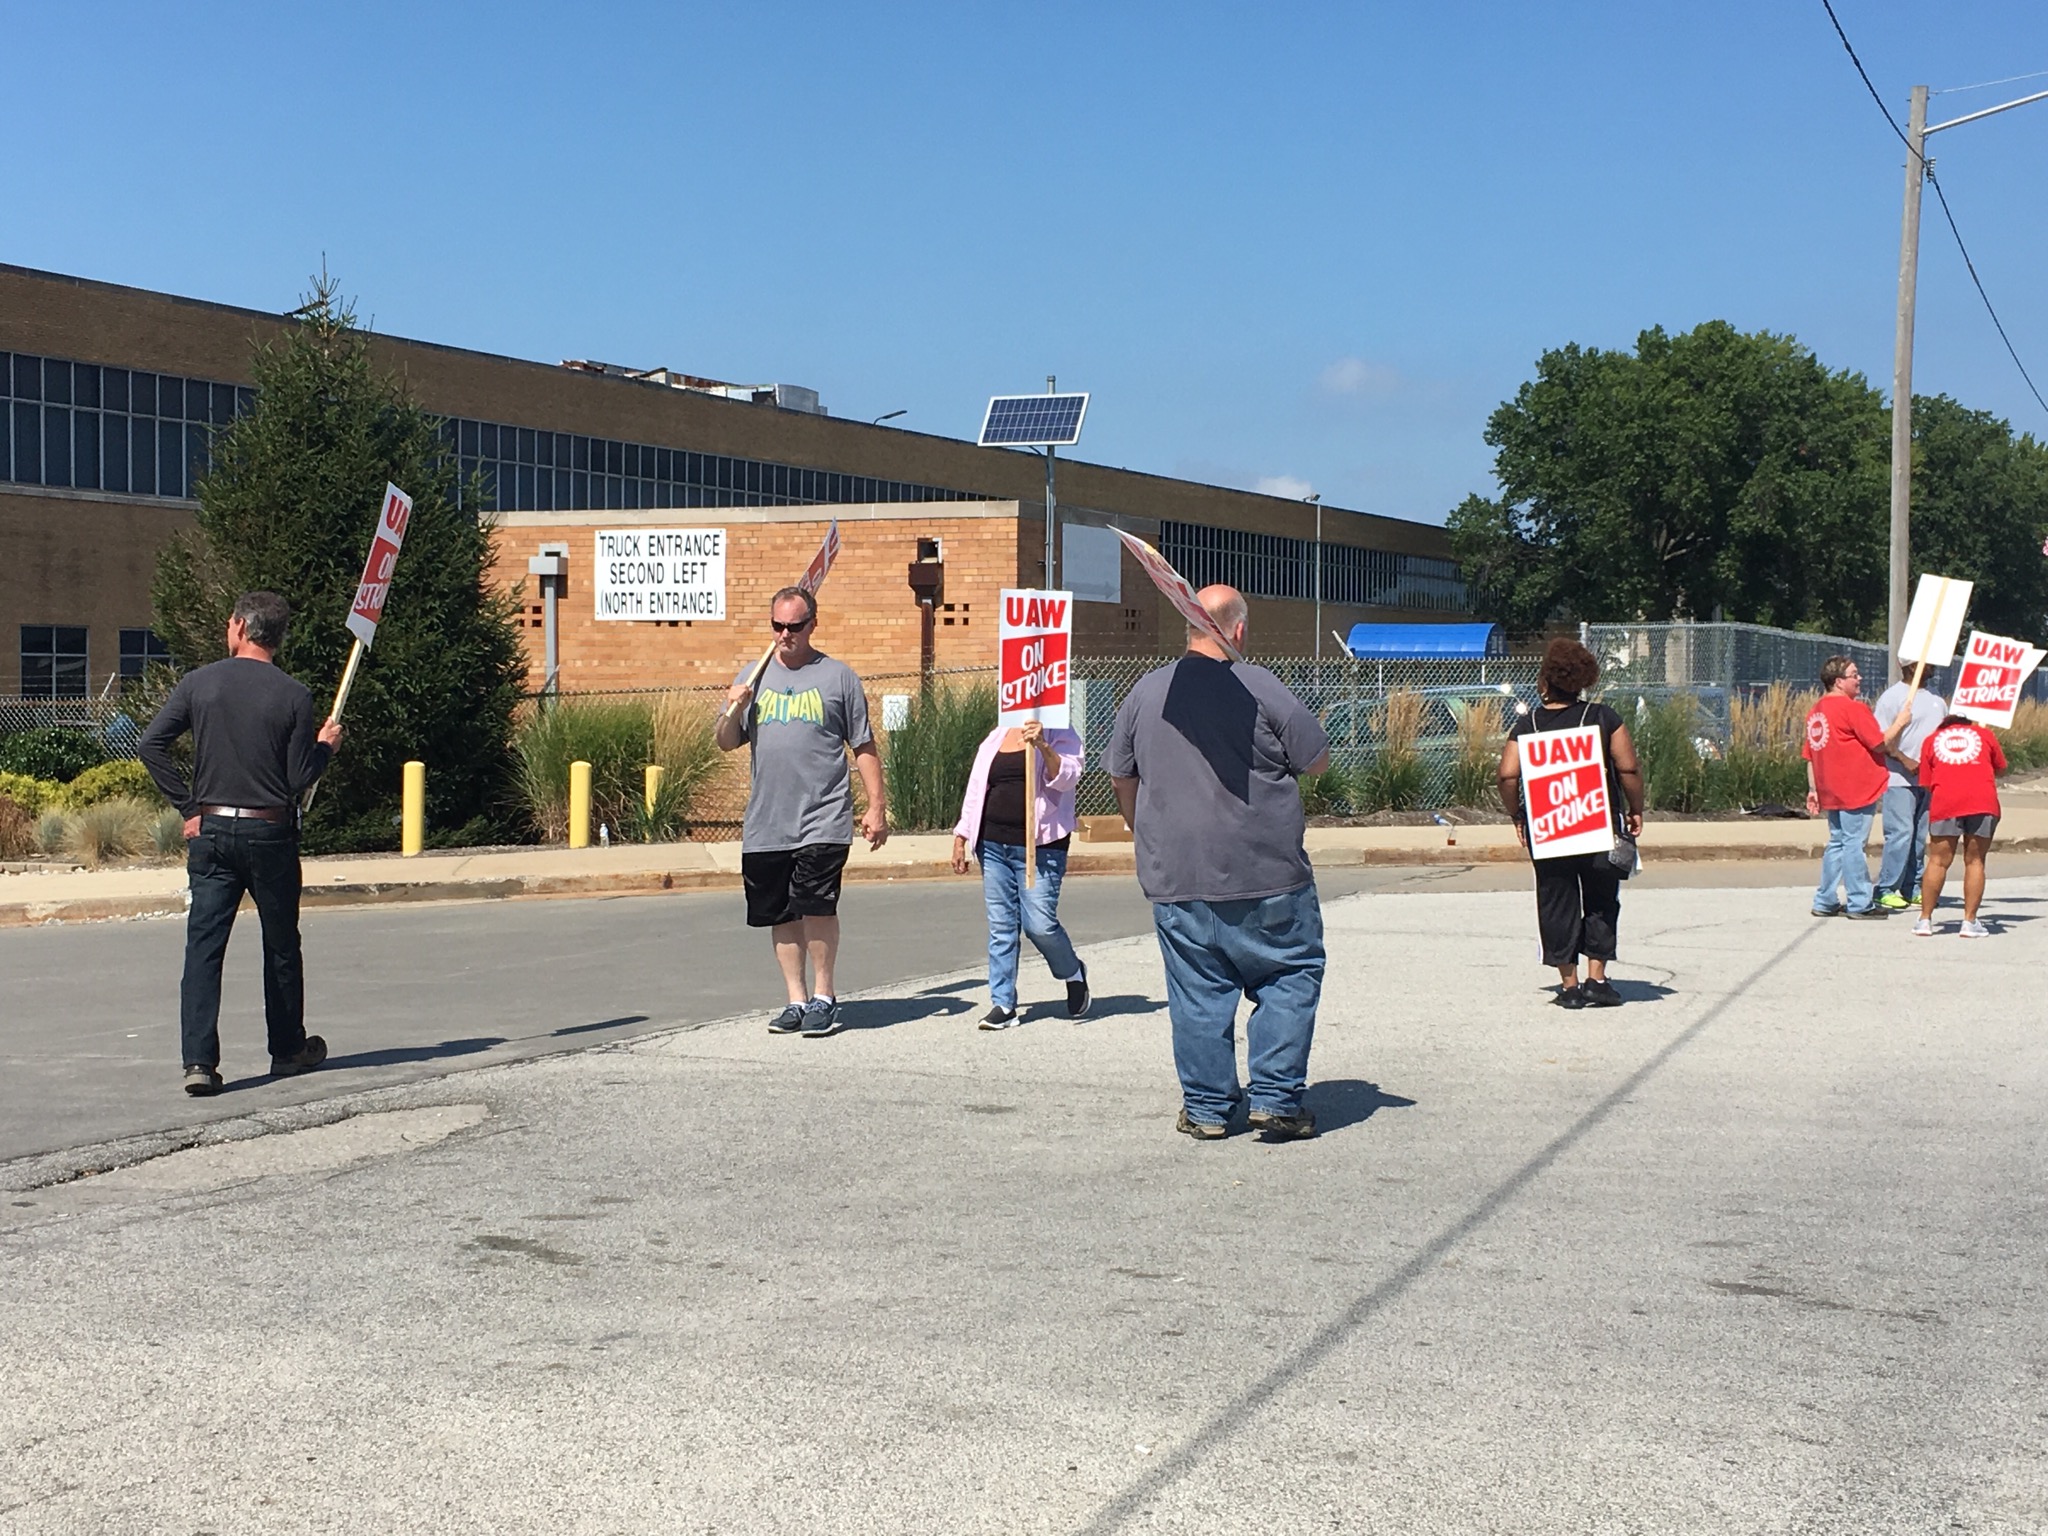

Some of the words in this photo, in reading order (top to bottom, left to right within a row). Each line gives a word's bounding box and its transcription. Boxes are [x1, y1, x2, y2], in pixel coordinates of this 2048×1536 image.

[386, 494, 409, 539] UA
[600, 535, 641, 557] TRUCK
[649, 534, 720, 556] ENTRANCE
[610, 562, 664, 584] SECOND
[673, 562, 708, 584] LEFT
[600, 590, 643, 616] (NORTH
[649, 590, 718, 616] ENTRANCE)
[1006, 597, 1067, 628] UAW
[1021, 638, 1045, 671] ON
[1973, 638, 2025, 665] UAW
[1002, 660, 1067, 709] STRIKE
[1976, 667, 2003, 685] ON
[756, 687, 824, 727] BATMAN
[1956, 684, 2018, 704] STRIKE
[1527, 734, 1594, 767] UAW
[1548, 771, 1579, 806] ON
[1533, 787, 1605, 841] STRIKE
